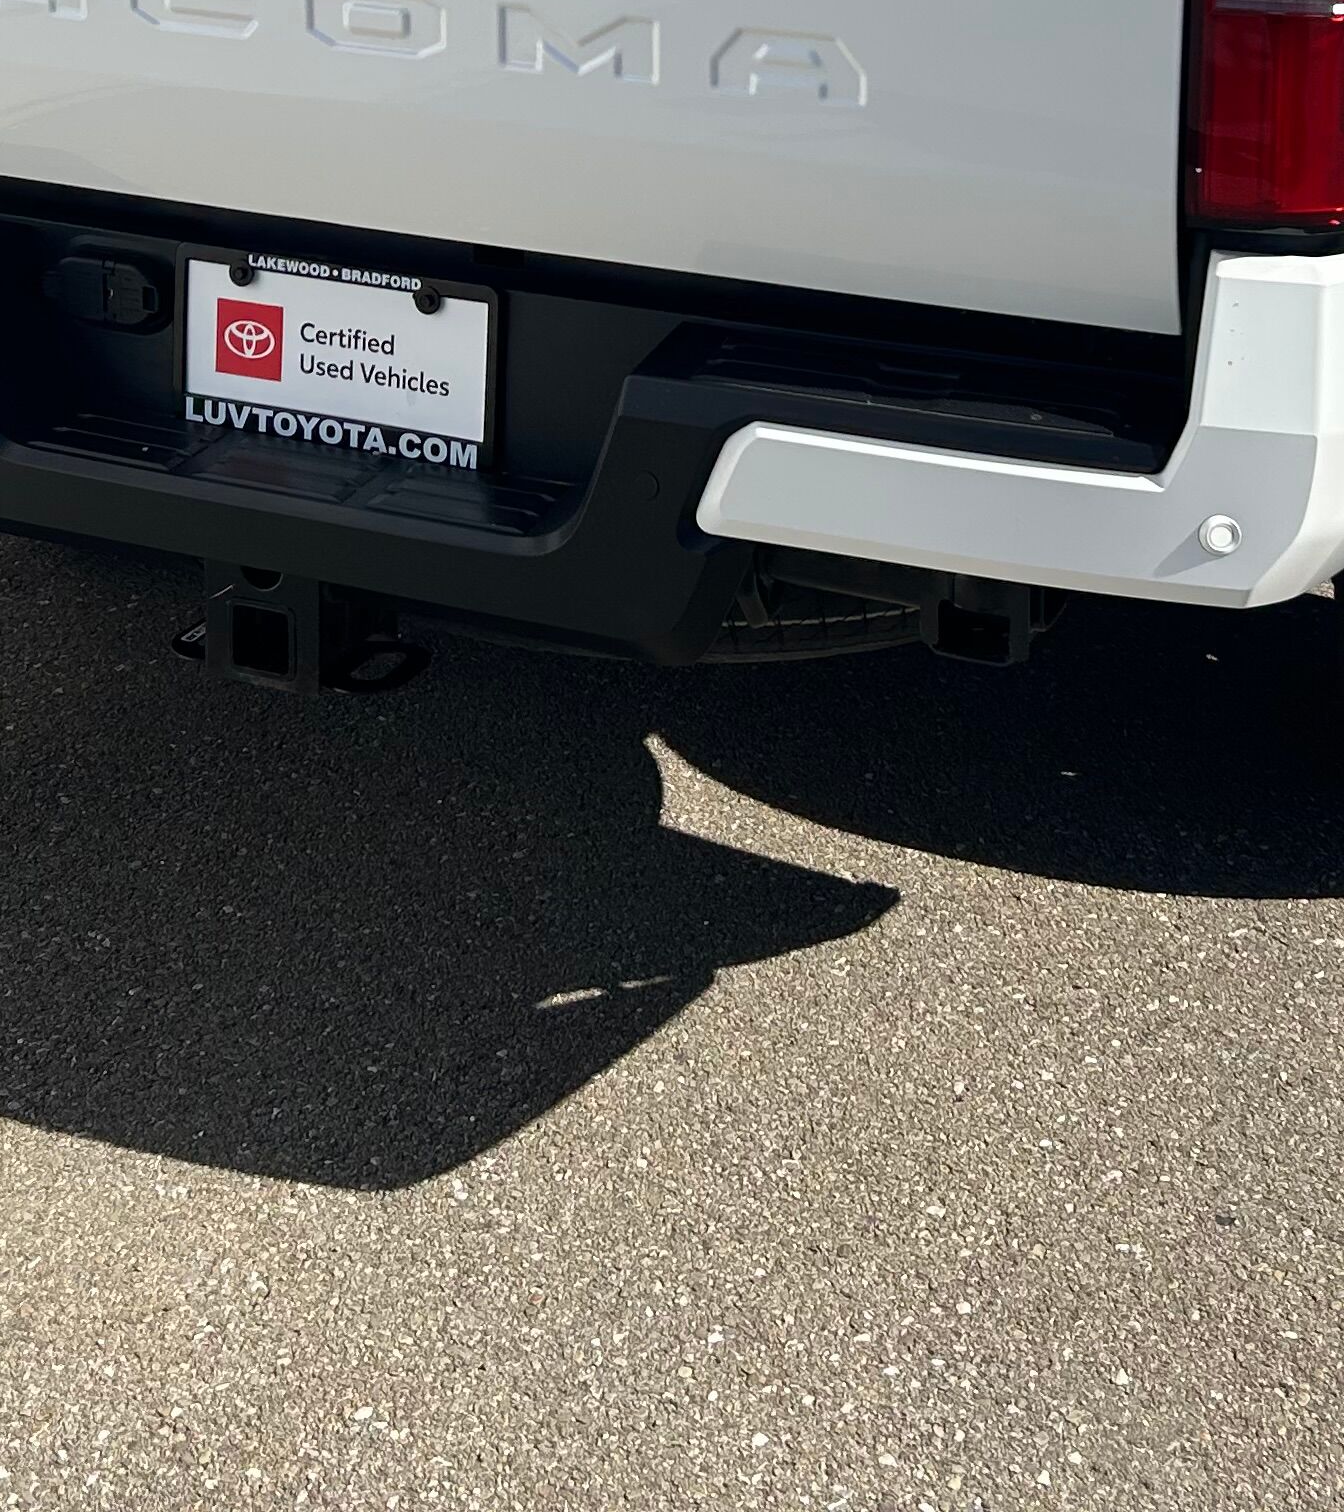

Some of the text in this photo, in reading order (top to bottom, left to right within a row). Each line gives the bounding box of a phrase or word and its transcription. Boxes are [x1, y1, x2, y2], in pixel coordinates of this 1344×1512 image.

[248, 254, 422, 291] LAKEWOOD BRADFORD
[299, 322, 395, 356] Certified
[299, 353, 450, 397] Used Vehicles
[185, 396, 478, 470] LUVTOYOTA.COM
